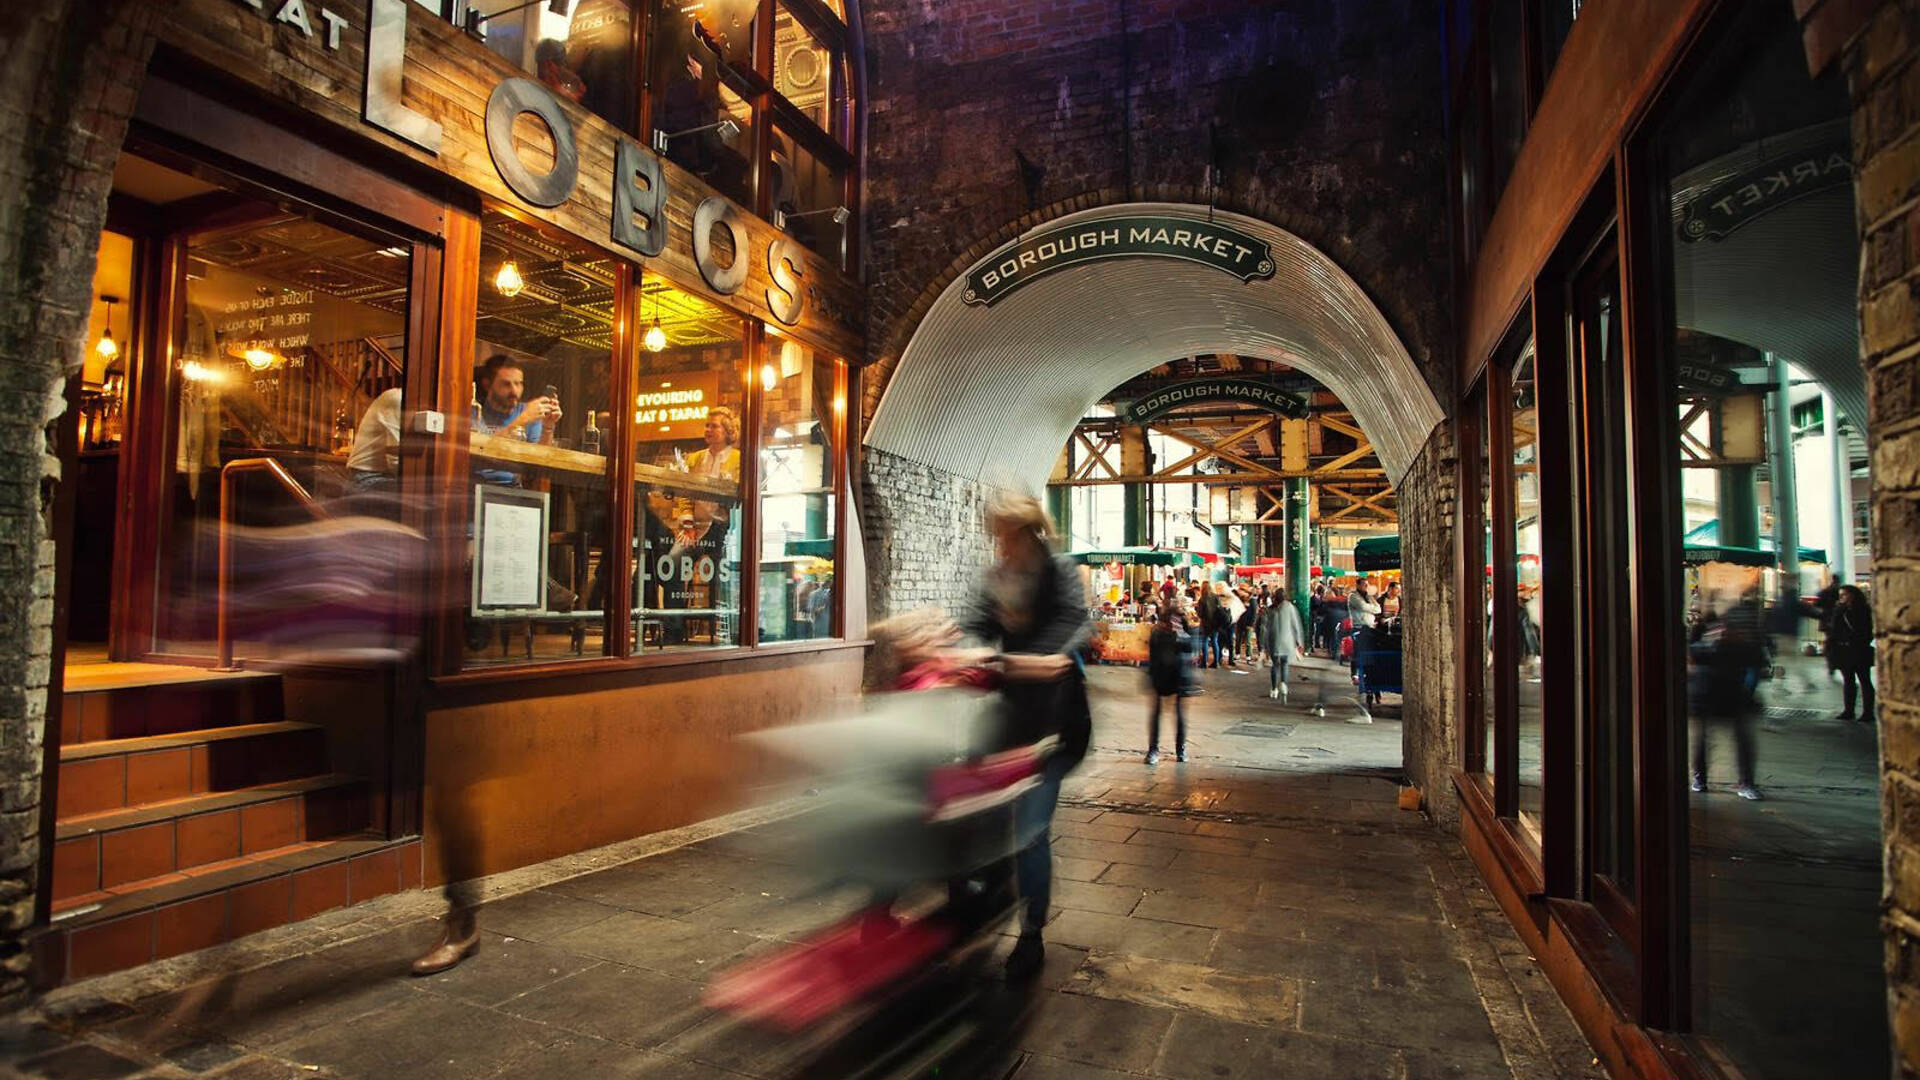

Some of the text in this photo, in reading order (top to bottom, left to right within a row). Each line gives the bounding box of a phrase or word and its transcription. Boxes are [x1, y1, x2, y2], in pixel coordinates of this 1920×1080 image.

[244, 0, 349, 50] AT
[362, 0, 804, 326] LOBOS
[981, 227, 1252, 290] BOROUGH MARKET
[636, 389, 703, 407] EVOURING
[1135, 385, 1297, 417] BOROUGH MARKET
[635, 408, 658, 424] EAT
[639, 554, 732, 583] LOBOS
